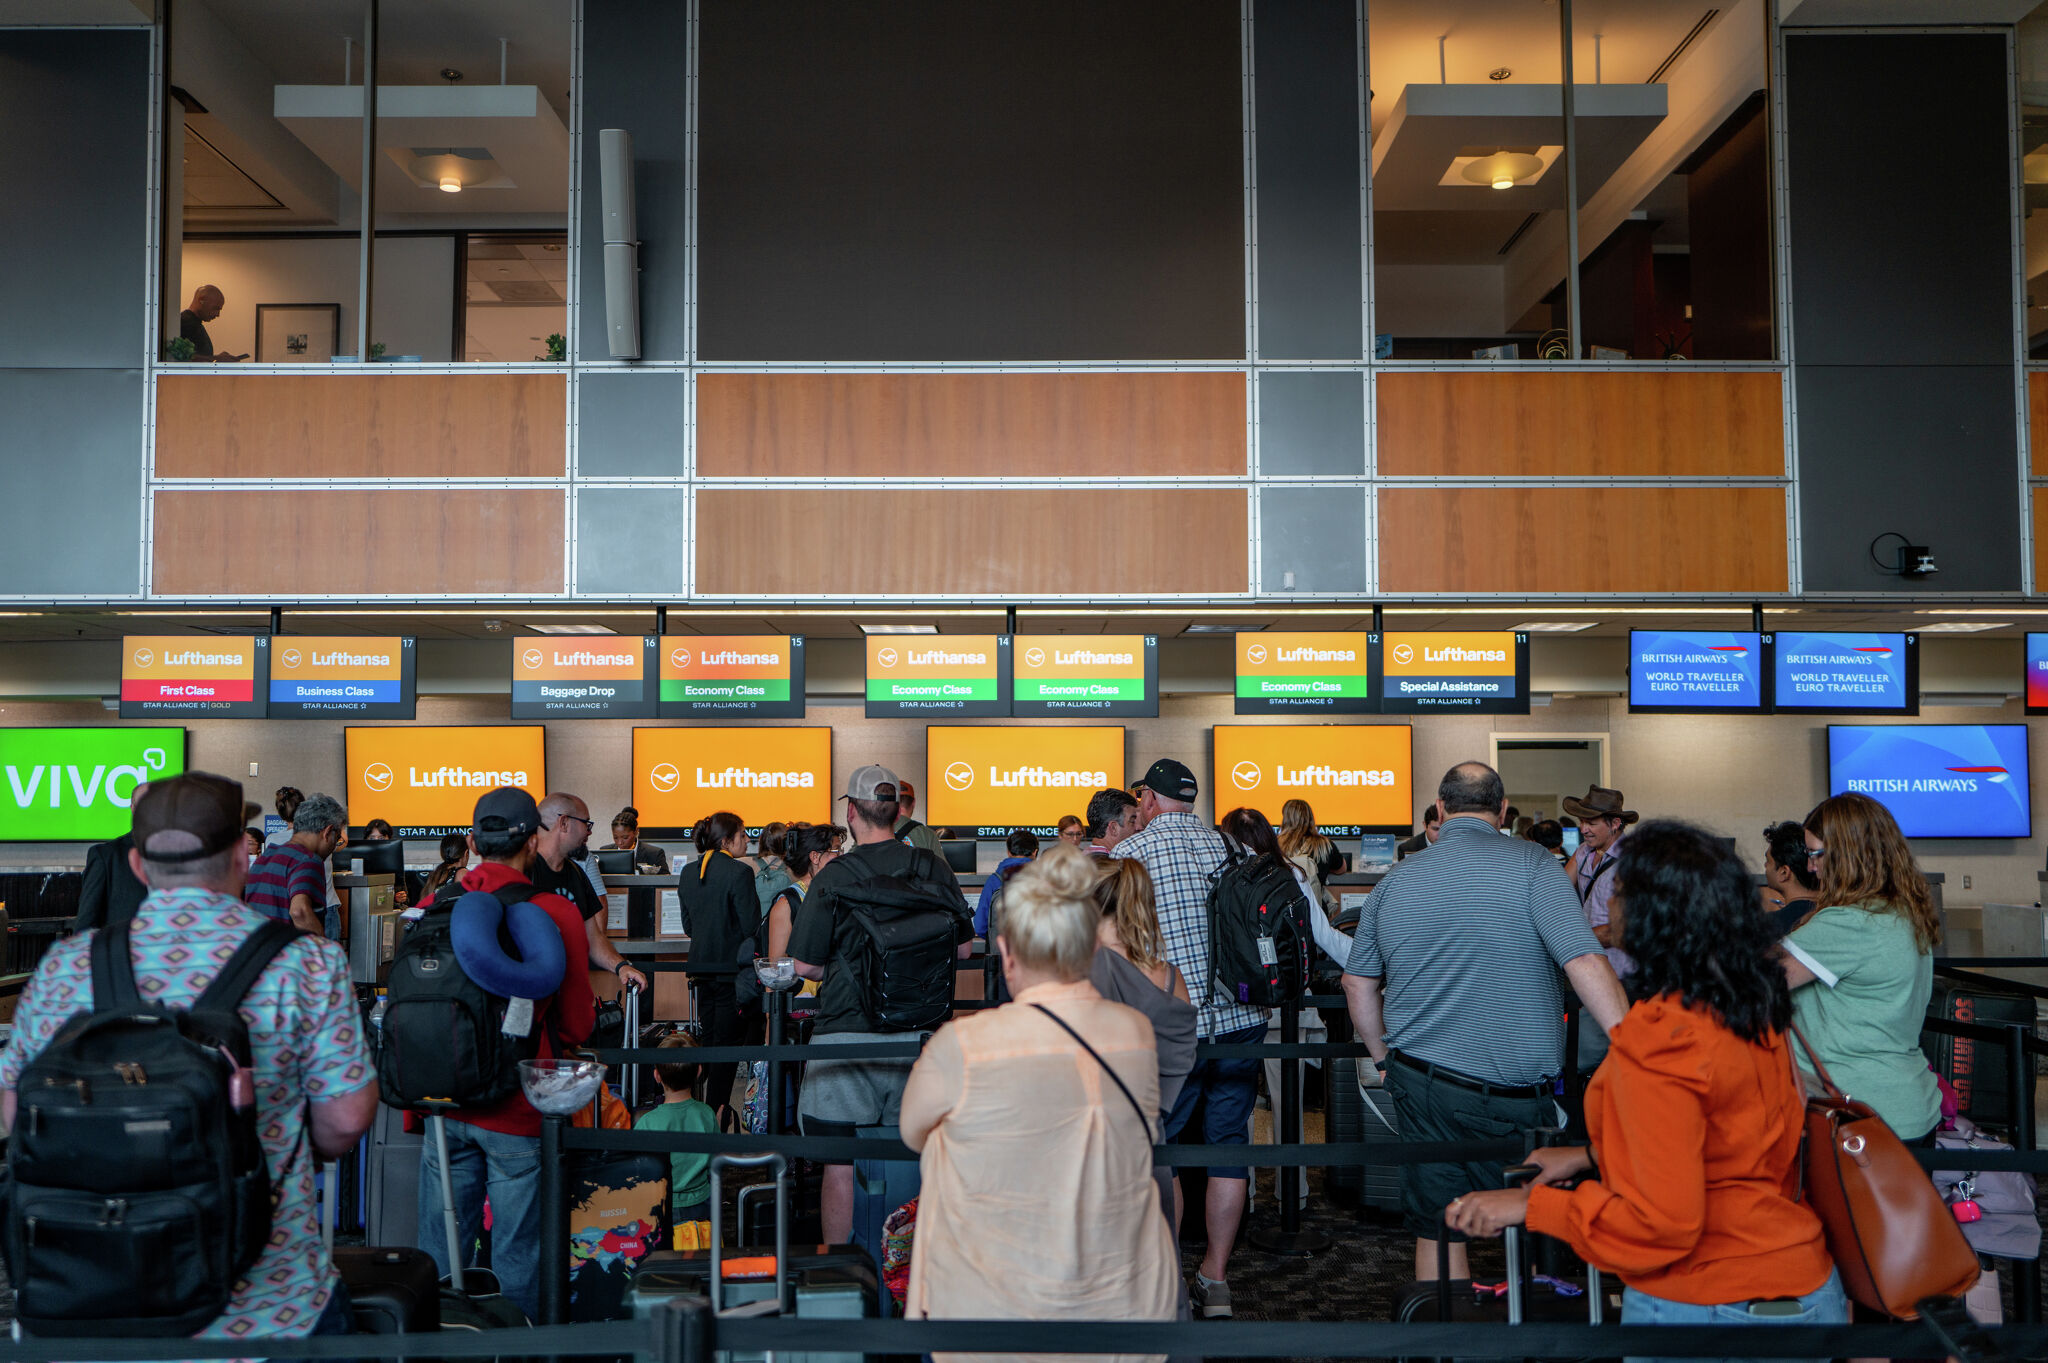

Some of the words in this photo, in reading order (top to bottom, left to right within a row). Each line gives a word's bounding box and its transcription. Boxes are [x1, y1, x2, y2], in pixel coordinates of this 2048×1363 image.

[256, 638, 266, 647] 18
[403, 639, 413, 648] 17
[645, 639, 656, 647] 16
[792, 638, 802, 647] 15
[998, 638, 1009, 646] 14
[1145, 638, 1156, 646] 13
[1368, 634, 1378, 643] 12
[1516, 634, 1526, 643] 11
[1761, 635, 1772, 644] 10
[1907, 636, 1914, 645] 9
[164, 651, 243, 665] Lufthansa
[312, 651, 390, 666] Lufthansa
[554, 651, 634, 666] Lufthansa
[701, 651, 779, 665] Lufthansa
[908, 651, 986, 665] Lufthansa
[1055, 651, 1133, 665] Lufthansa
[1277, 647, 1356, 662] Lufthansa
[1424, 647, 1506, 662] Lufthansa
[1642, 654, 1682, 664] BRITISH
[1683, 654, 1728, 664] AIRWAYS
[1786, 655, 1827, 665] BRITISH
[1828, 655, 1872, 665] AIRWAYS
[1645, 672, 1684, 681] WORLD
[1686, 672, 1745, 681] TRAVELLER
[1791, 673, 1829, 682] WORLD
[1831, 673, 1889, 682] TRAVELLER
[160, 685, 184, 696] First
[185, 685, 215, 696] Class
[296, 686, 343, 696] Business
[345, 686, 374, 696] Class
[540, 686, 588, 698] Baggage
[589, 686, 615, 697] Drop
[685, 685, 734, 697] Economy
[735, 685, 765, 695] Class
[892, 685, 942, 697] Economy
[943, 685, 972, 695] Class
[1039, 685, 1089, 697] Economy
[1090, 685, 1119, 695] Class
[1261, 682, 1311, 693] Economy
[1312, 682, 1342, 692] Class
[1400, 682, 1439, 693] Special
[1440, 682, 1499, 692] Assistance
[1651, 682, 1679, 692] EURO
[1681, 682, 1740, 692] TRAVELLER
[1795, 683, 1824, 693] EURO
[1826, 683, 1885, 693] TRAVELLER
[410, 766, 528, 788] Lufthansa
[696, 767, 814, 788] Lufthansa
[990, 766, 1107, 788] Lufthansa
[1277, 765, 1394, 786] Lufthansa
[1848, 778, 1909, 792] BRITISH
[1912, 778, 1978, 792] AIRWAYS
[399, 828, 426, 836] STAR
[977, 827, 1005, 836] STAR
[1008, 827, 1059, 836] AANCE
[600, 1208, 628, 1218] RUSSIA
